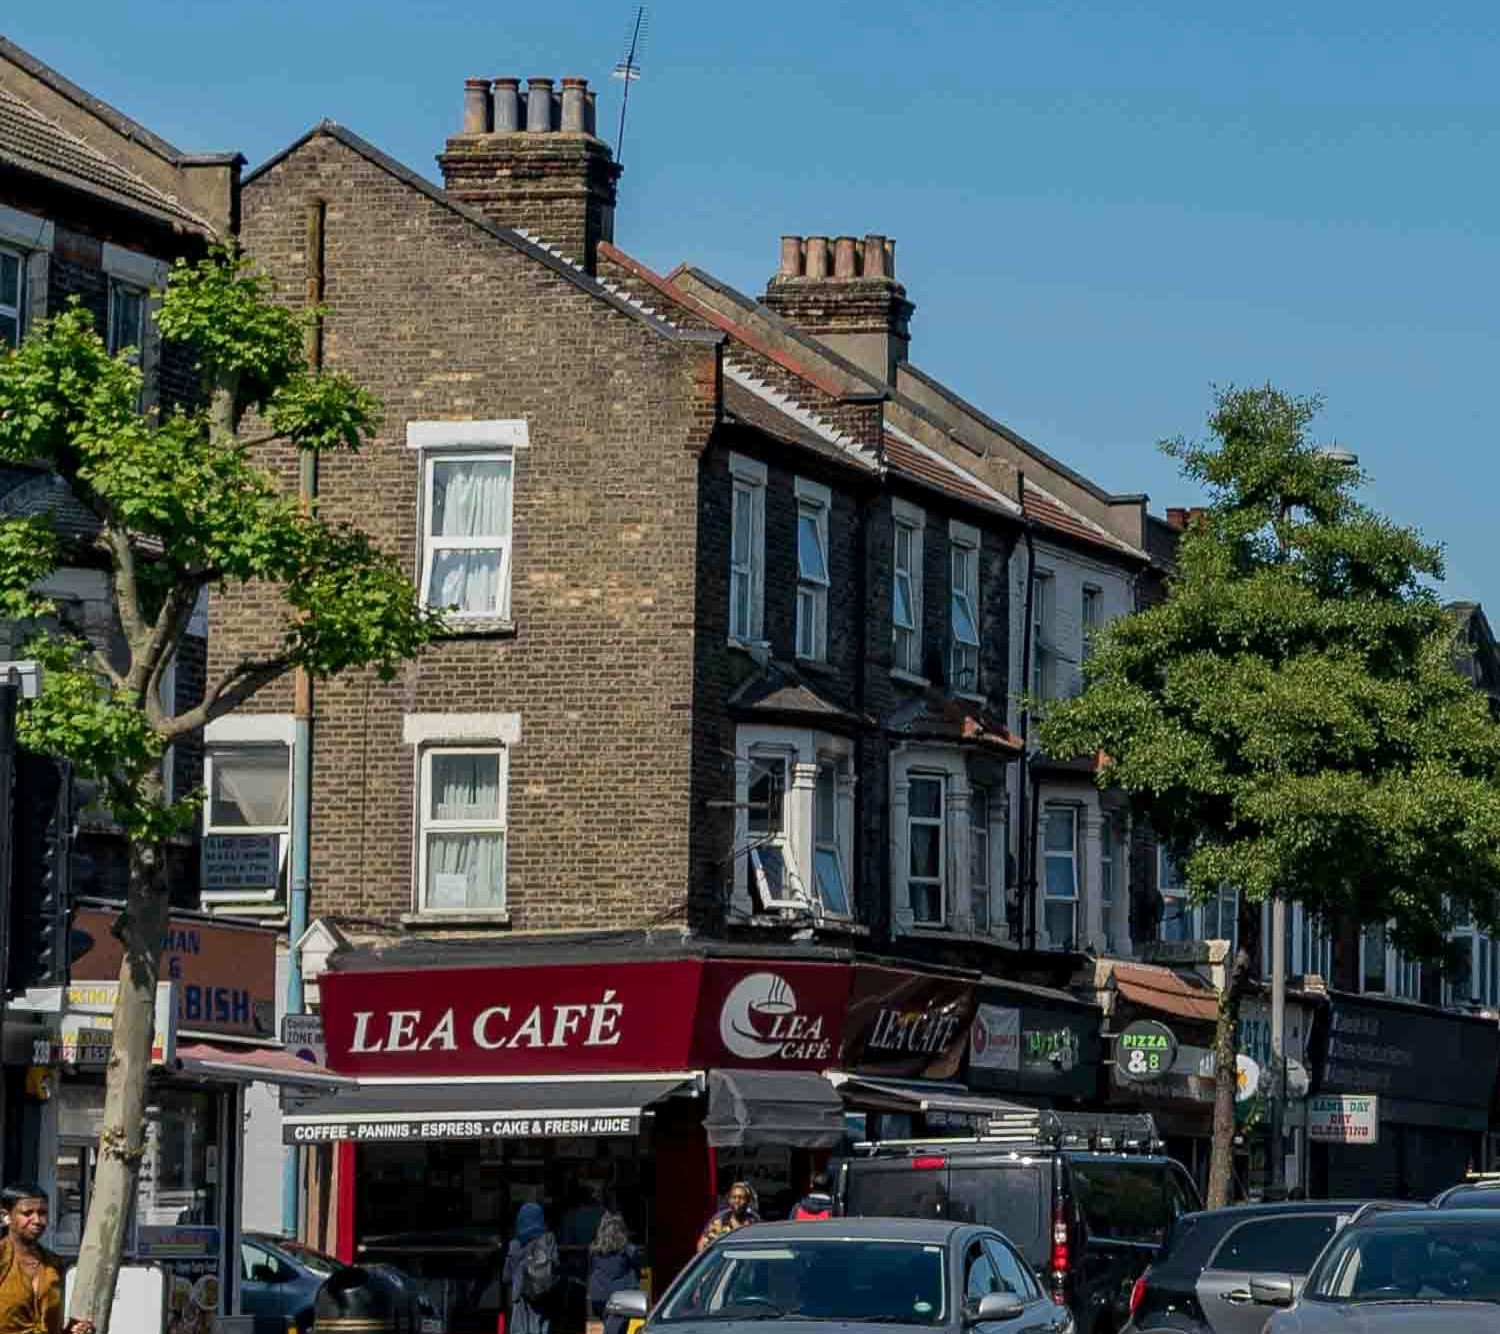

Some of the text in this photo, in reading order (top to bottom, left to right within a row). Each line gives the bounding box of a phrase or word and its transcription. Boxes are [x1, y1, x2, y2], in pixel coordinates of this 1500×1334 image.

[179, 986, 249, 1021] BISH
[348, 989, 624, 1054] LEA CAFÉ
[286, 1031, 312, 1044] ZONE
[770, 1015, 831, 1060] LEA CAFÉ
[1123, 1034, 1168, 1048] PIZZA
[1128, 1049, 1148, 1073] &
[1350, 1099, 1370, 1112] DAY
[1329, 1114, 1352, 1124] DRY
[295, 1117, 630, 1140] COFFEE PANINIS ESPRESS CAKE & FRESH JUICE
[1312, 1125, 1369, 1137] CLEANING
